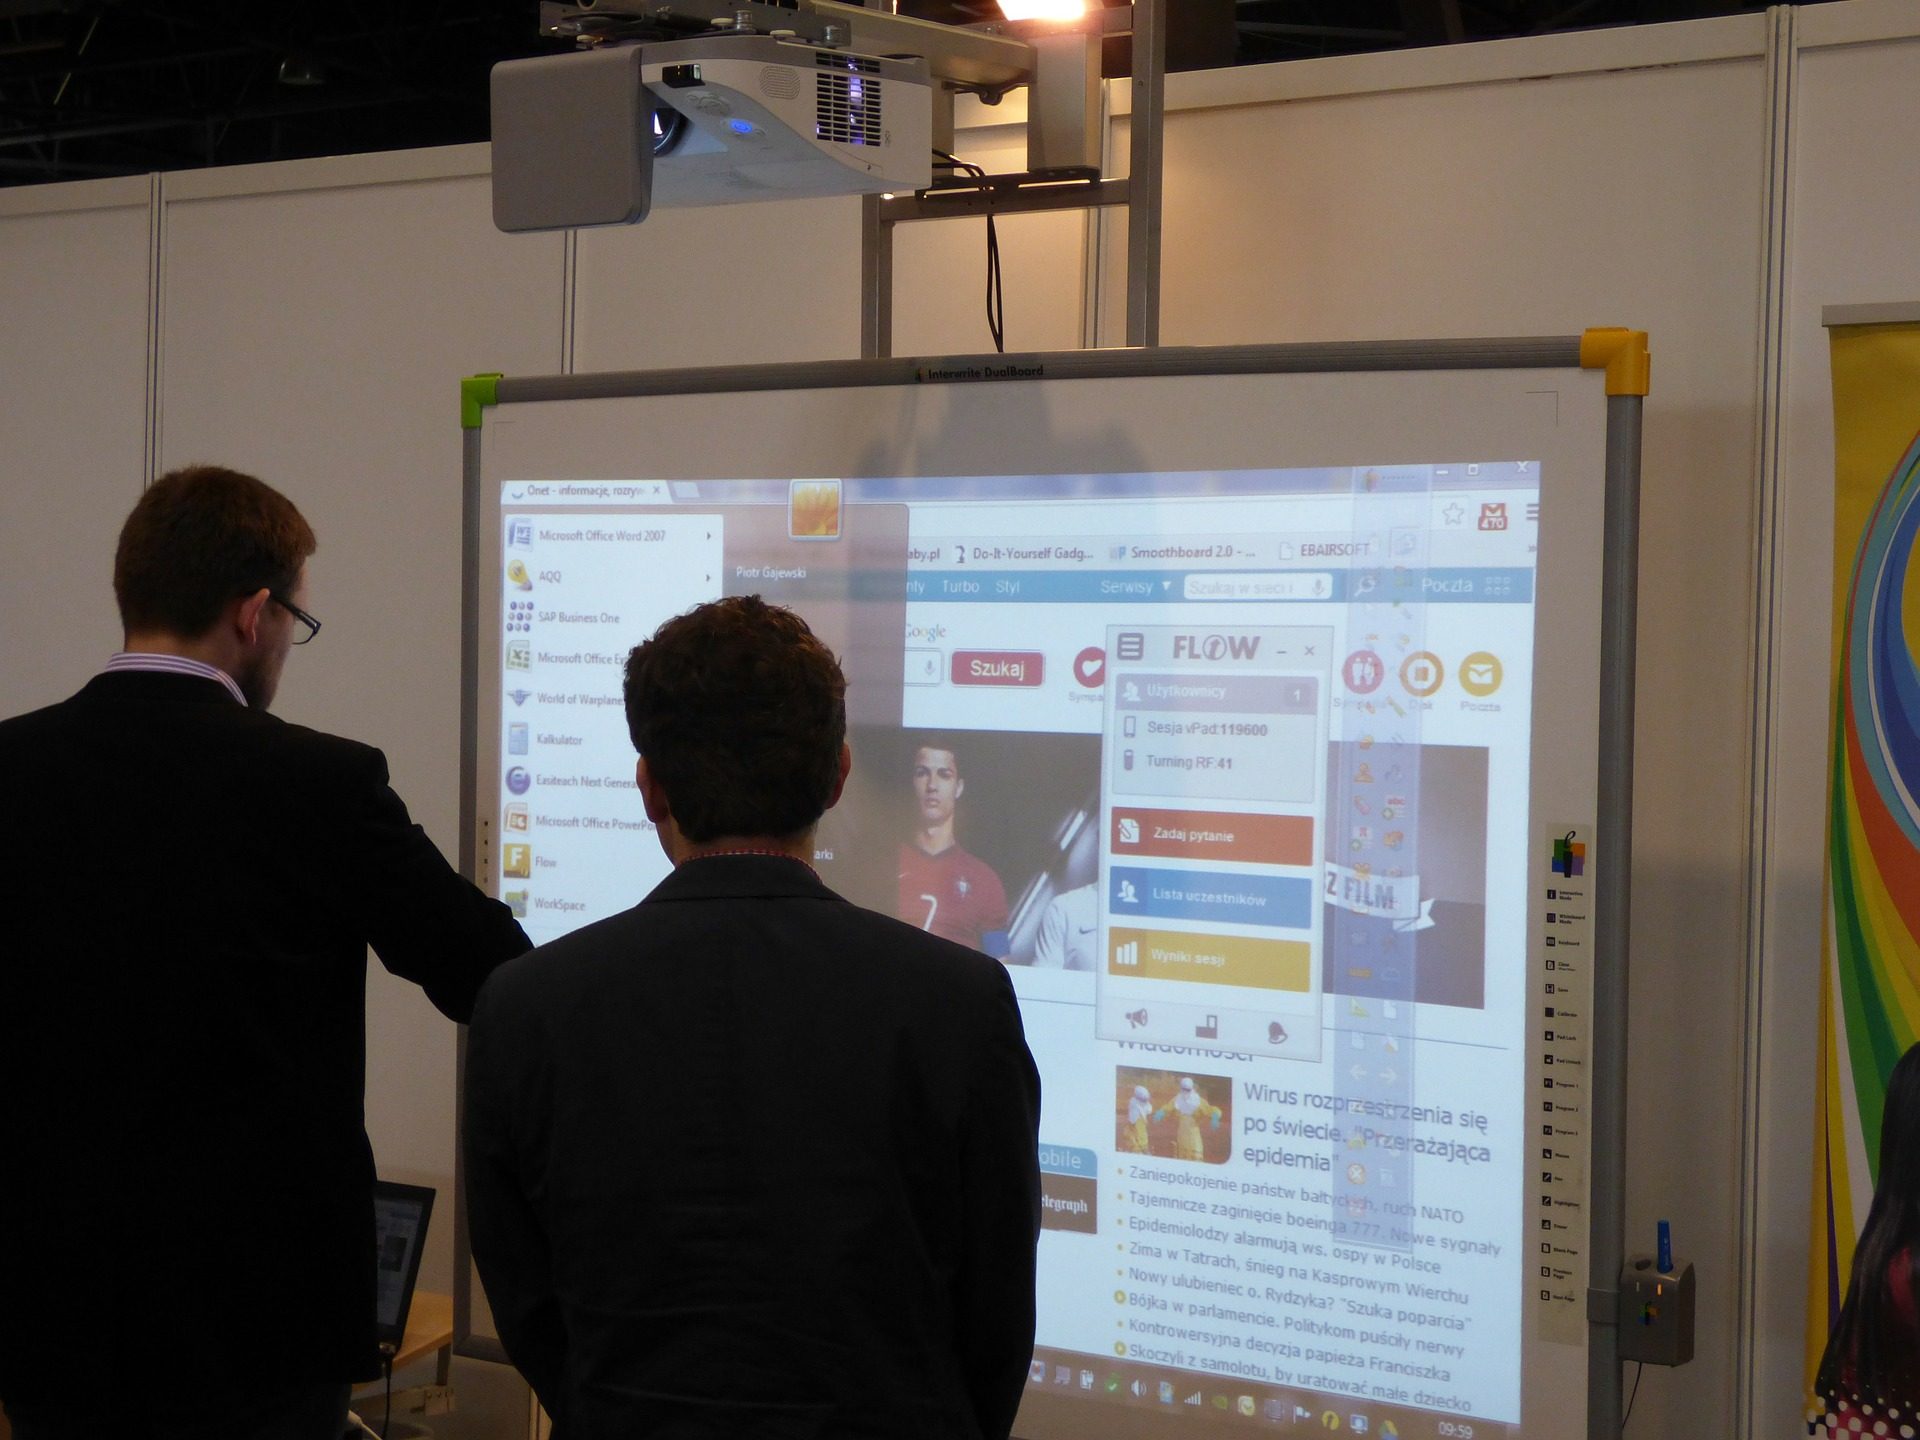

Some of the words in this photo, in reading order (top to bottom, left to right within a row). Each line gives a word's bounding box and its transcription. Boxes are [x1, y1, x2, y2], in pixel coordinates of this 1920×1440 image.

[984, 365, 1044, 377] DualBoard
[528, 485, 550, 496] Onet
[540, 529, 583, 541] Microsoft
[586, 529, 613, 541] Office
[616, 529, 642, 541] Word
[644, 529, 666, 541] 2007
[973, 547, 1051, 560] Do-It-Yourself
[1131, 546, 1213, 559] Smoothboard
[1216, 546, 1233, 558] 2.0
[1300, 543, 1371, 557] EBAIRSOFT
[539, 571, 561, 584] AQQ
[737, 567, 760, 579] Piotr
[762, 567, 807, 581] Gajewski
[943, 580, 980, 593] Turbo
[995, 580, 1021, 594] Styl
[1101, 580, 1153, 594] Serwisy
[1422, 577, 1473, 592] Poczta
[538, 612, 556, 624] SAP
[559, 613, 597, 625] Business
[600, 613, 620, 625] One
[538, 653, 582, 665] Microsoft
[585, 653, 613, 665] Office
[970, 660, 1025, 681] Szukaj
[538, 693, 566, 705] World
[567, 693, 577, 705] of
[1293, 690, 1301, 701] 1
[1147, 721, 1183, 736] Sesja
[537, 733, 583, 746] Kalkulator
[1147, 754, 1193, 770] Turning
[536, 774, 578, 787] Easiteach
[581, 776, 602, 788] Next
[536, 815, 579, 828] Microsoft
[583, 817, 609, 829] Office
[1153, 826, 1187, 842] Zadaj
[1188, 829, 1235, 844] pytanie
[535, 856, 557, 868] Flow
[1153, 887, 1184, 901] Lista
[1186, 890, 1267, 908] uczestników
[1344, 876, 1395, 910] FILM
[534, 898, 586, 912] WorkSpace
[1152, 948, 1192, 965] Wyniki
[1194, 951, 1226, 968] sesji
[1244, 1082, 1298, 1105] Wirus
[1459, 1110, 1488, 1136] się
[1244, 1117, 1267, 1135] po
[1129, 1165, 1238, 1192] Zaniepokojenie
[1241, 1181, 1296, 1201] państw
[1383, 1201, 1416, 1218] ruch
[1421, 1205, 1464, 1225] NATO
[1130, 1190, 1207, 1214] Tajemnicze
[1211, 1203, 1282, 1225] zaginięcie
[1287, 1211, 1347, 1235] boeinga
[1390, 1227, 1436, 1246] Nowe
[1440, 1236, 1502, 1259] sygnały
[1129, 1215, 1229, 1243] Epidemiolodzy
[1234, 1231, 1299, 1256] alarmują
[1332, 1250, 1369, 1266] ospy
[1375, 1253, 1387, 1265] w
[1391, 1254, 1442, 1275] Polsce
[1129, 1241, 1162, 1259] Zima
[1167, 1250, 1179, 1261] w
[1183, 1249, 1241, 1272] Tatrach,
[1245, 1257, 1285, 1279] śnieg
[1289, 1266, 1309, 1280] na
[1312, 1268, 1400, 1294] Kasprowym
[1405, 1283, 1469, 1306] Wierchu
[1129, 1267, 1168, 1285] Nowy
[1172, 1273, 1243, 1297] ulubieniec
[1247, 1286, 1262, 1299] o.
[1265, 1287, 1335, 1311] Rydzyka?
[1129, 1292, 1168, 1312] Bójka
[1172, 1300, 1184, 1313] w
[1188, 1303, 1281, 1328] parlamencie.
[1284, 1316, 1355, 1340] Politykom
[1359, 1327, 1411, 1351] puściły
[1415, 1340, 1465, 1360] nerwy
[1129, 1319, 1241, 1348] Kontrowersyjna
[1246, 1336, 1301, 1359] decyzja
[1305, 1348, 1366, 1369] papieża
[1369, 1357, 1452, 1383] Franciszka
[1129, 1344, 1184, 1365] Skoczyli
[1188, 1356, 1196, 1367] z
[1200, 1357, 1271, 1380] samolotu,
[1275, 1366, 1293, 1384] by
[1297, 1375, 1369, 1395] uratować
[1372, 1384, 1409, 1403] małe
[1413, 1390, 1472, 1413] dziecko
[1438, 1421, 1473, 1439] 09:59
